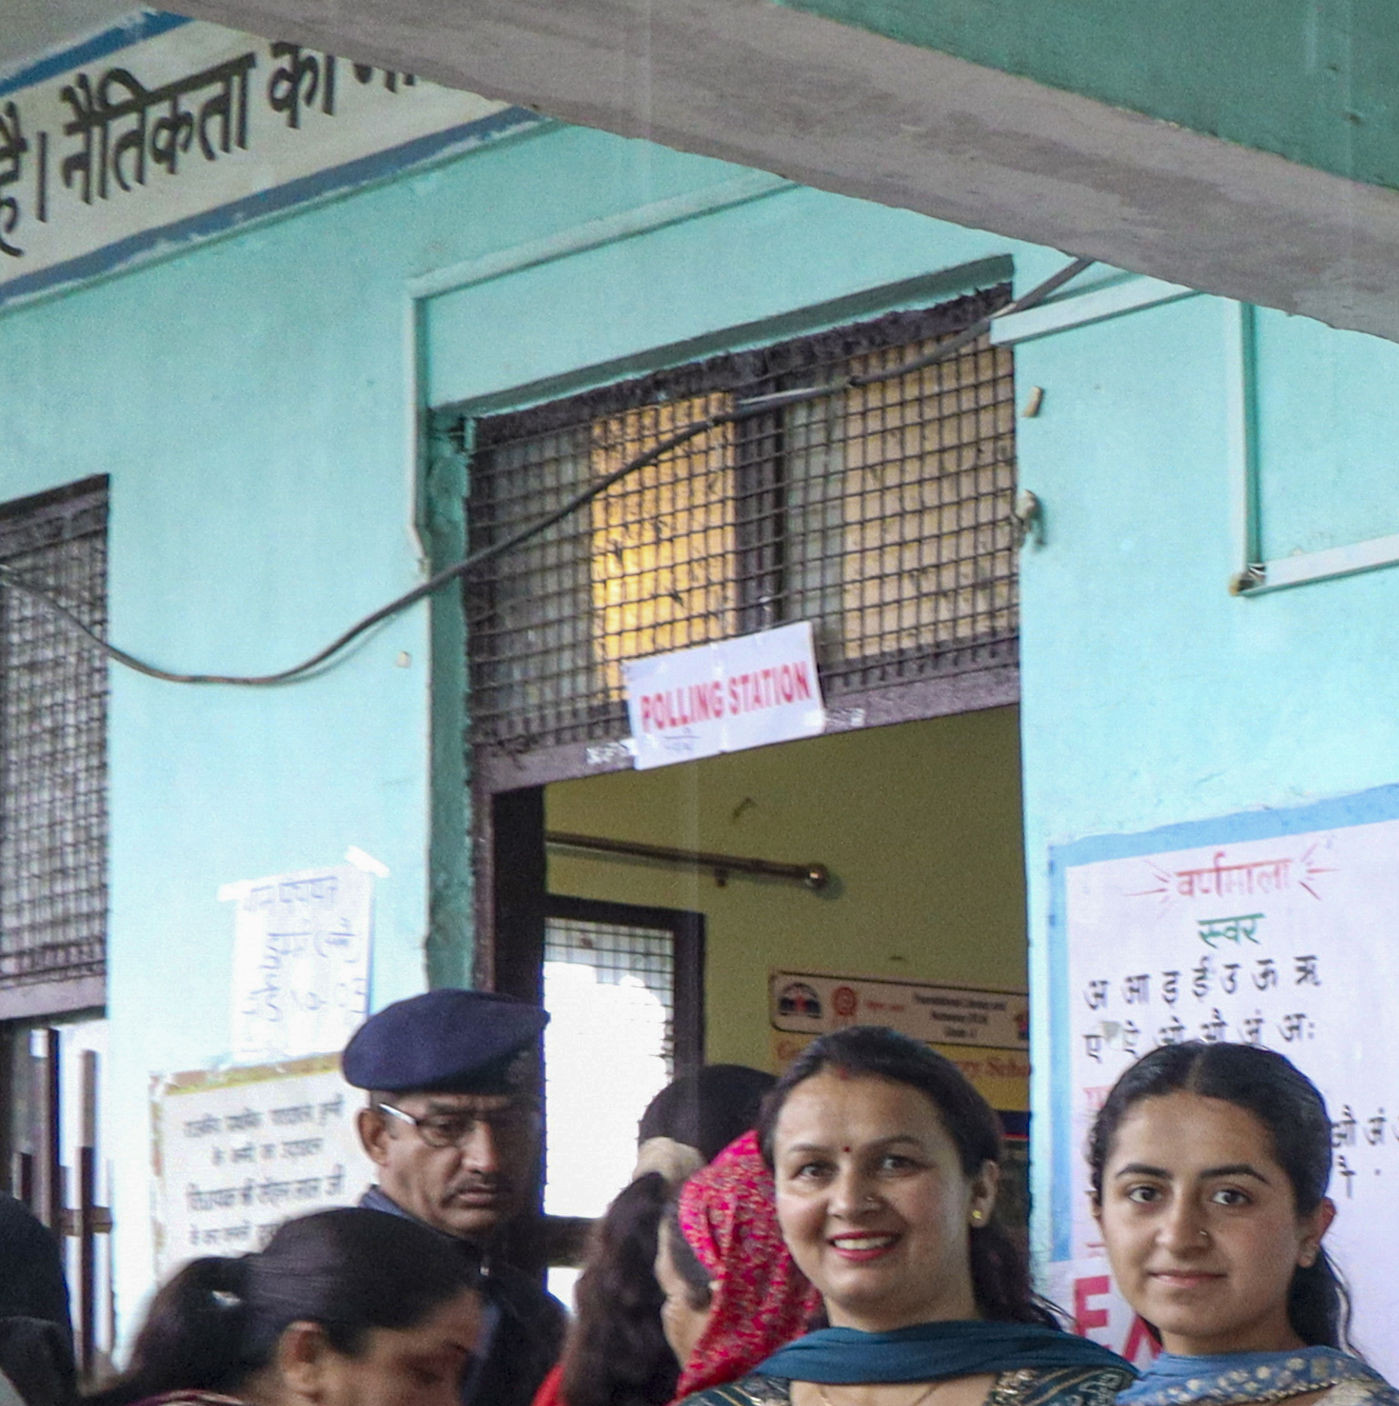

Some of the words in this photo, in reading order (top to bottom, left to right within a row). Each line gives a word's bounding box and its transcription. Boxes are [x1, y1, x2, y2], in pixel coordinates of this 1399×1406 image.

[61, 69, 257, 205] नैतिकता
[640, 681, 724, 733] POLLING
[728, 661, 811, 716] STATION
[1176, 852, 1292, 897] वर्णमाला
[1198, 913, 1266, 949] स्वर
